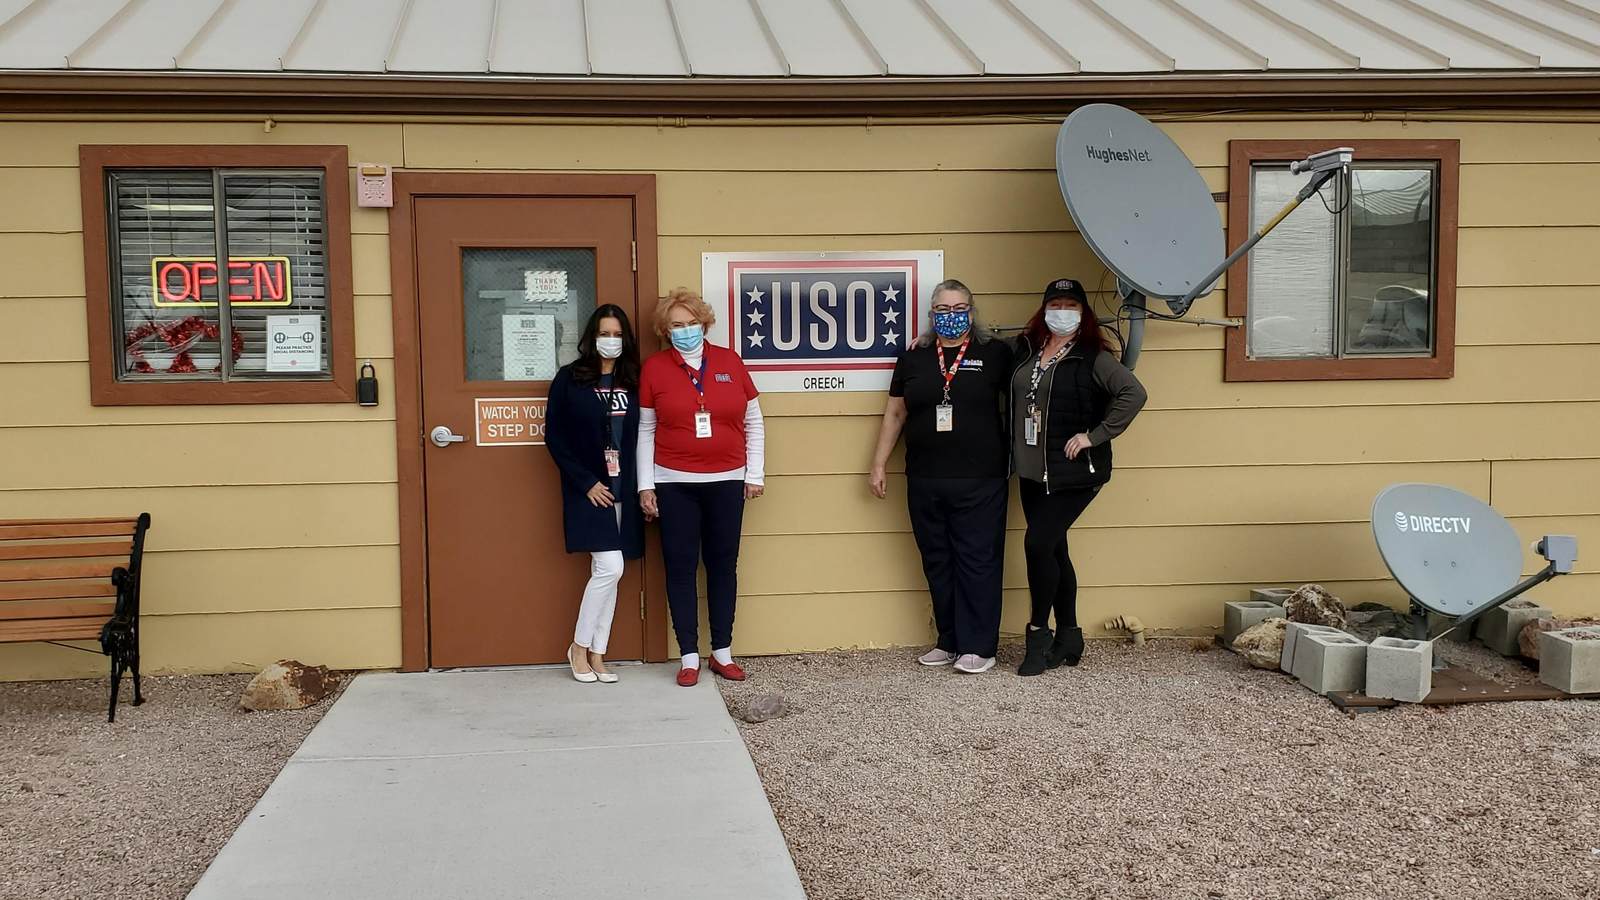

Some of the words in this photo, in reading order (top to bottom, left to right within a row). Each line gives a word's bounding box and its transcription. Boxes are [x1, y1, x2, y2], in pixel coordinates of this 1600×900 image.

[1086, 145, 1150, 163] HughesNet
[160, 262, 284, 301] OPEN
[771, 280, 875, 351] USO
[803, 377, 845, 390] CREECH
[481, 406, 519, 419] WATCH
[487, 424, 524, 438] STEP
[1409, 515, 1471, 534] DIRECTV
